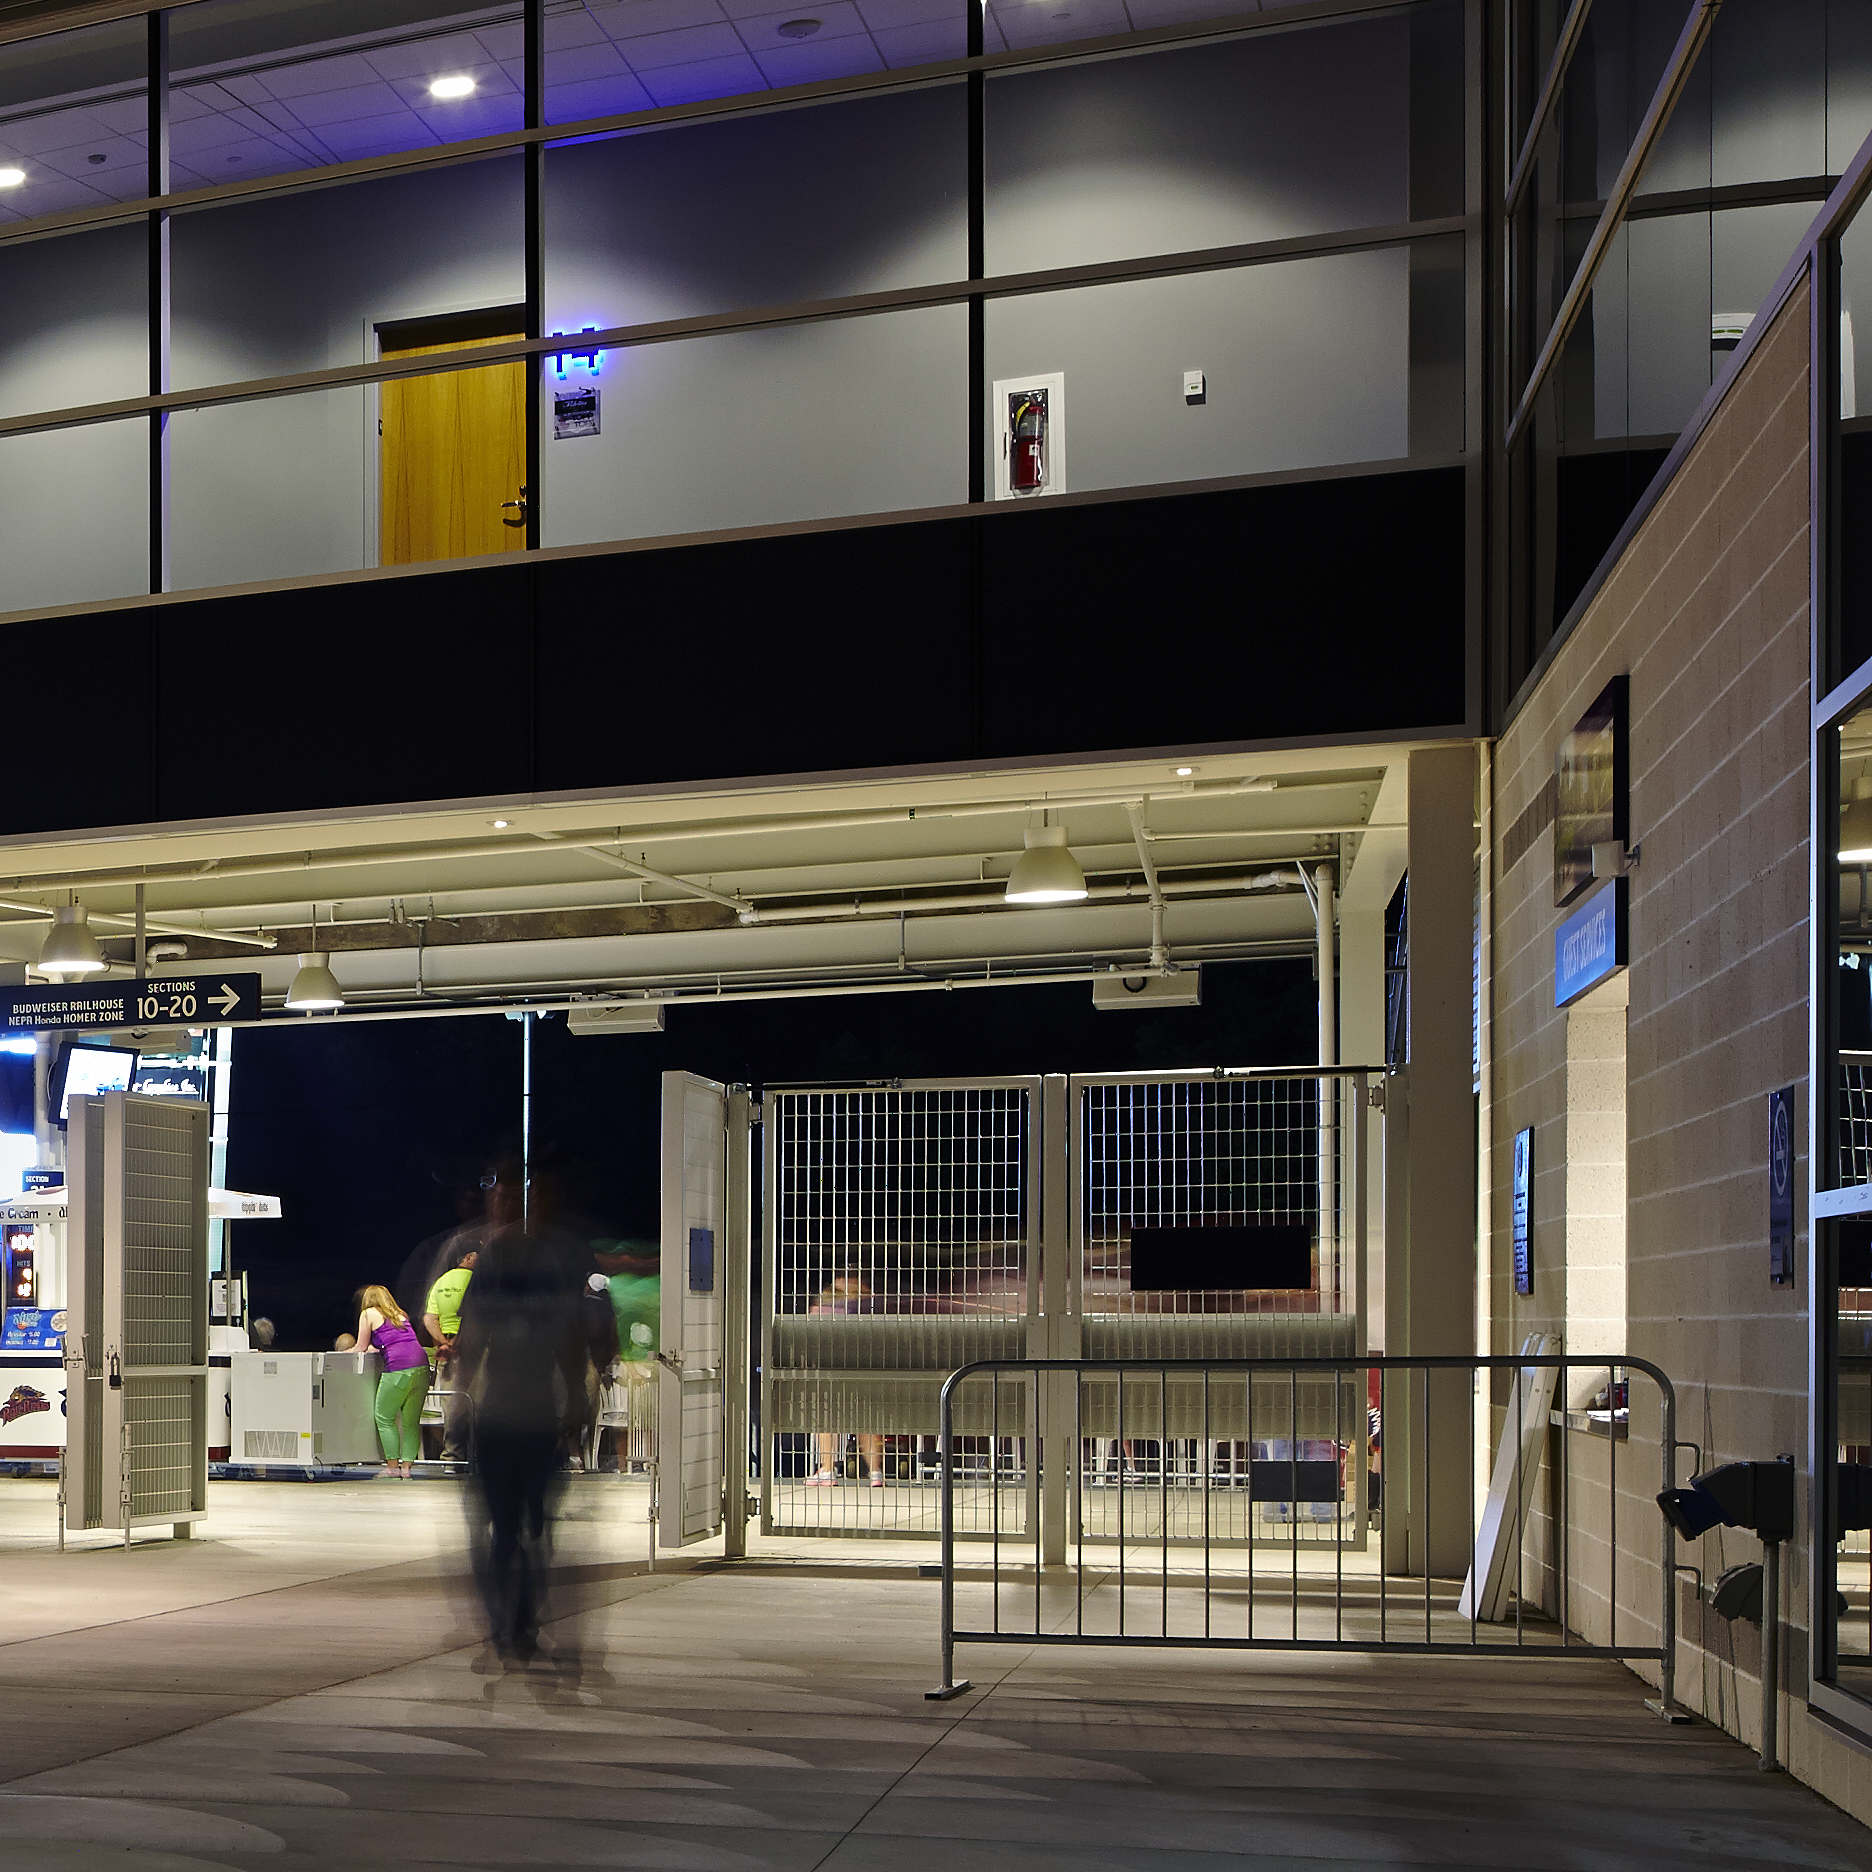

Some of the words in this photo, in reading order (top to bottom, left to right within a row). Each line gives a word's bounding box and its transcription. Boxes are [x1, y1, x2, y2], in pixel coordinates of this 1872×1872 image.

[147, 981, 196, 994] SECTIONS
[12, 1001, 68, 1015] BUDWEISER
[70, 998, 124, 1012] RAILHOUSE
[136, 994, 197, 1020] 10-20
[8, 1015, 33, 1027] NEPA
[34, 1014, 61, 1025] Honda
[63, 1012, 97, 1024] HOMER
[98, 1010, 125, 1022] ZONE
[7, 1208, 39, 1219] Cream
